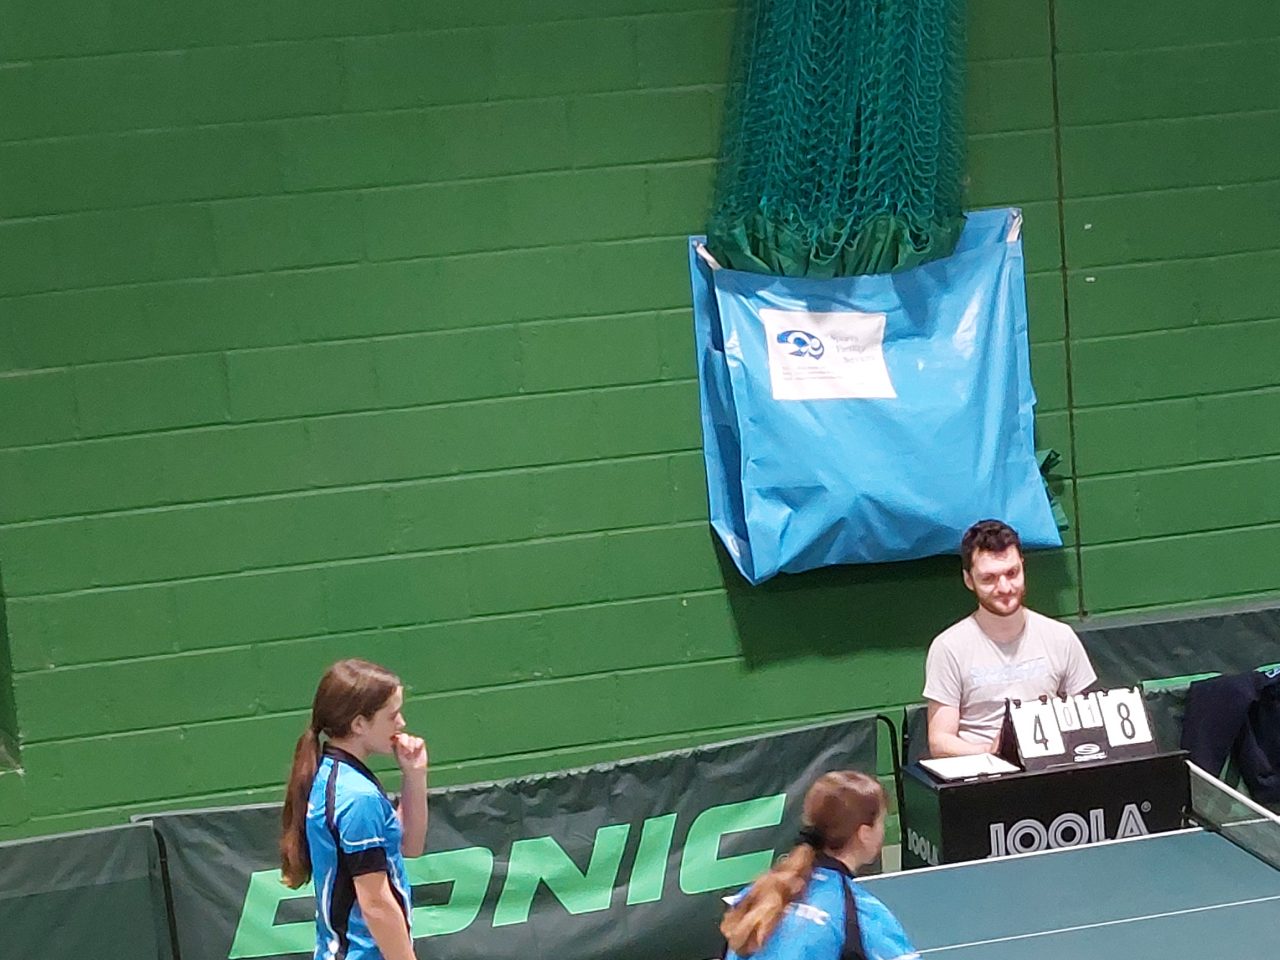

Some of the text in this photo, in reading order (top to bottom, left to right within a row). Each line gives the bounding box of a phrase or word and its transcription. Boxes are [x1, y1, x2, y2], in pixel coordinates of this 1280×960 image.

[1033, 713, 1049, 751] 4
[1116, 701, 1136, 740] 8
[987, 803, 1149, 859] JOOLA
